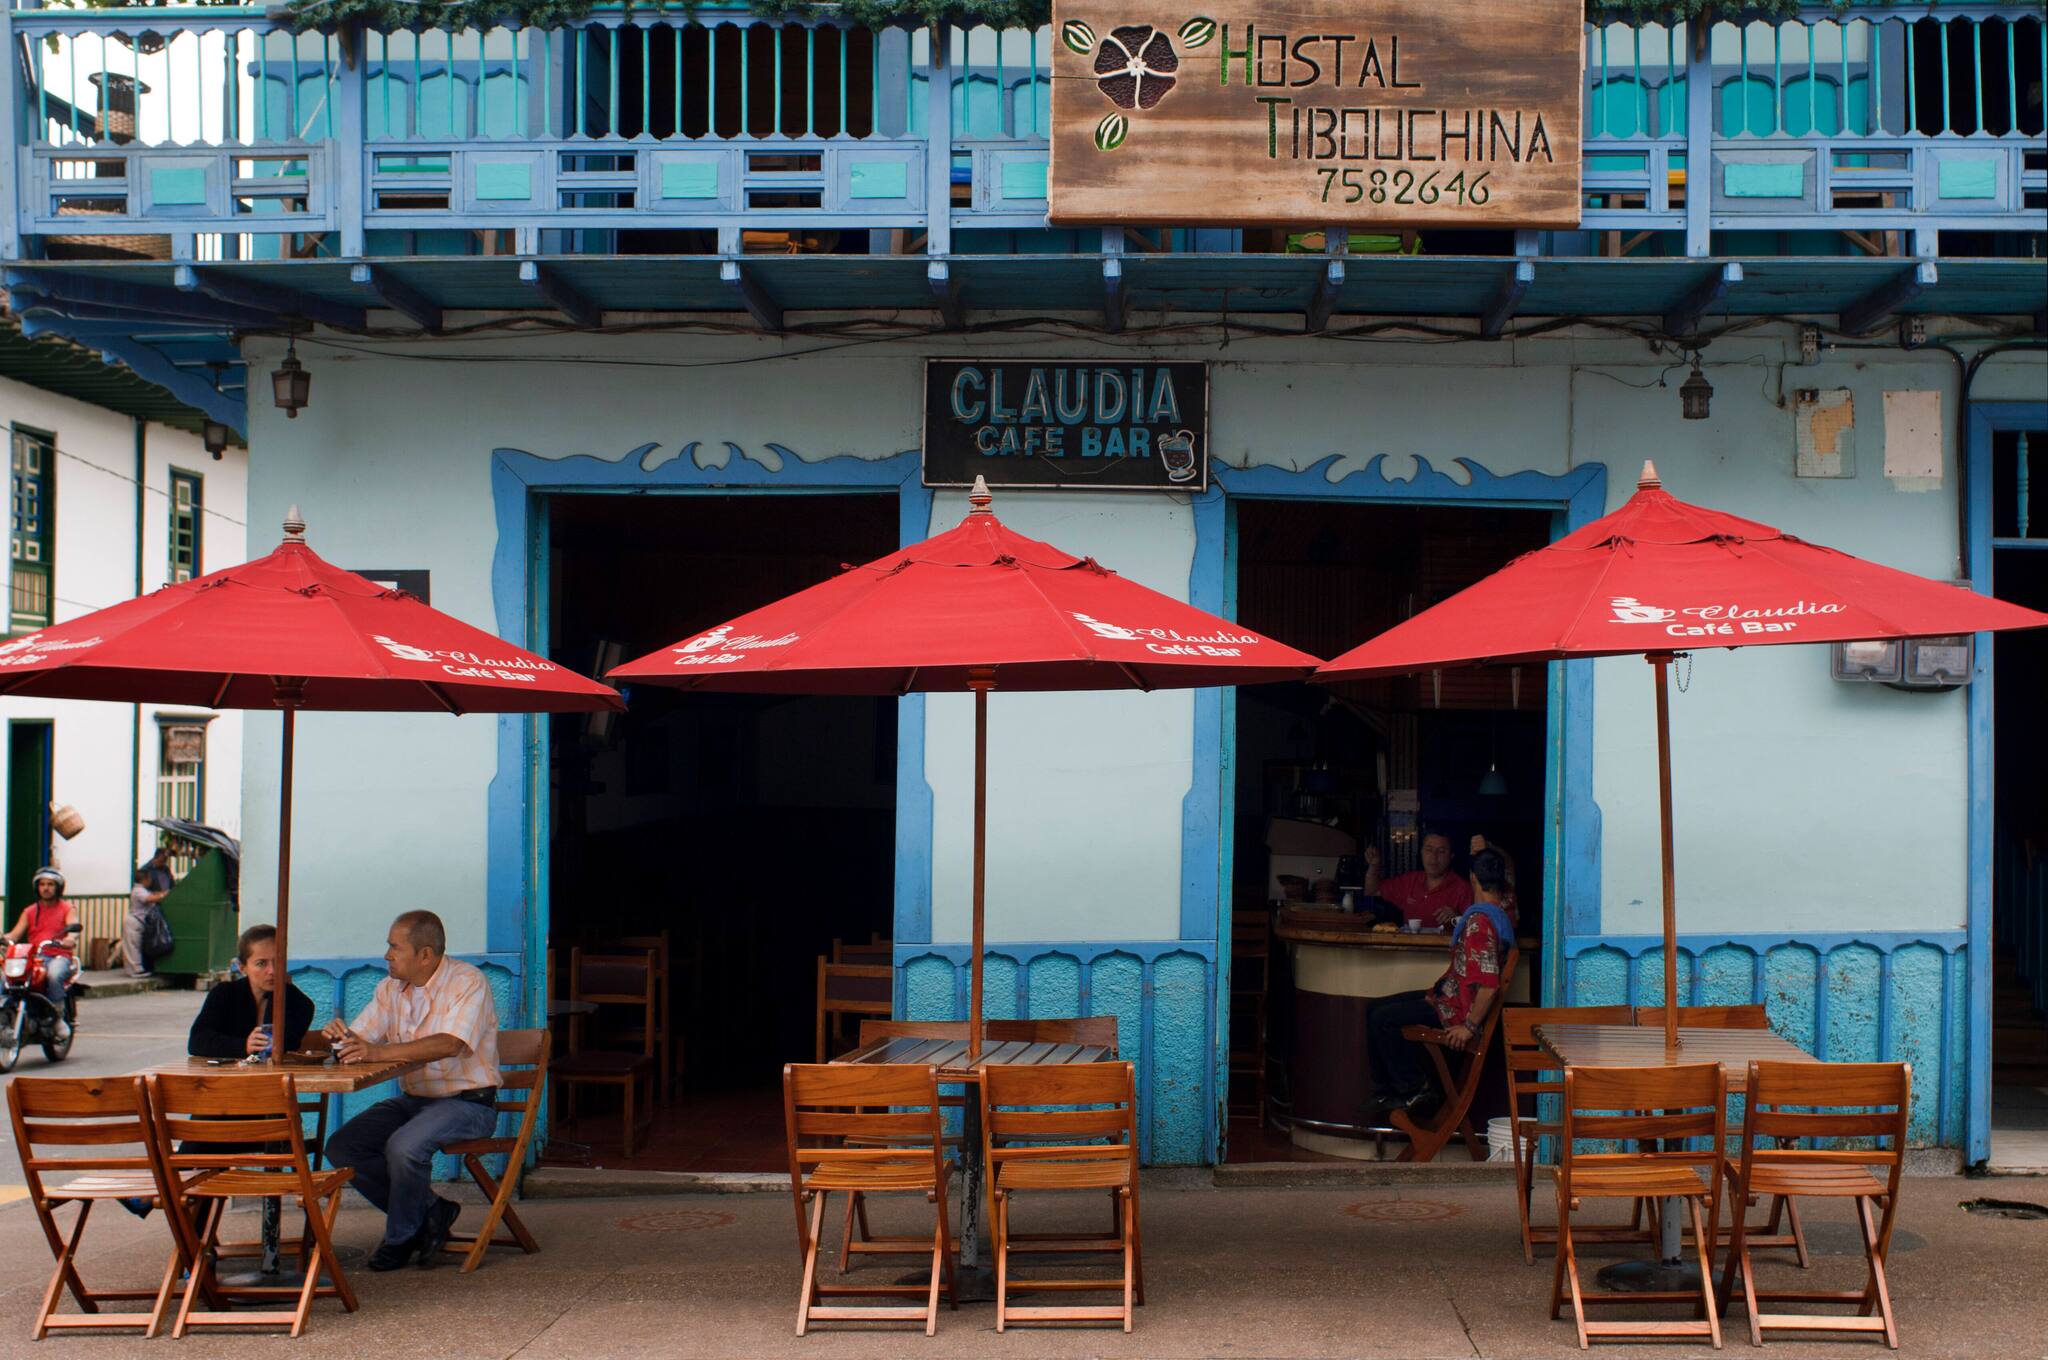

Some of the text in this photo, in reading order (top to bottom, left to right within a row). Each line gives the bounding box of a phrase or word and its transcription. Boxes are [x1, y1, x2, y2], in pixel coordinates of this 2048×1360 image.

[1220, 23, 1421, 88] HOSTAL
[1256, 97, 1553, 163] TIBOUCHINA
[1317, 168, 1491, 206] 7582646
[951, 366, 1182, 425] CLAUDIA
[976, 425, 1150, 457] CAFE BAR
[1682, 600, 1847, 621] Claudia
[1136, 628, 1259, 645] Claudia
[1666, 621, 1797, 637] Café Bar
[435, 650, 556, 671] Claudia
[708, 653, 746, 664] Bar
[1146, 643, 1242, 657] Café Bar
[442, 665, 536, 682] Café Bar
